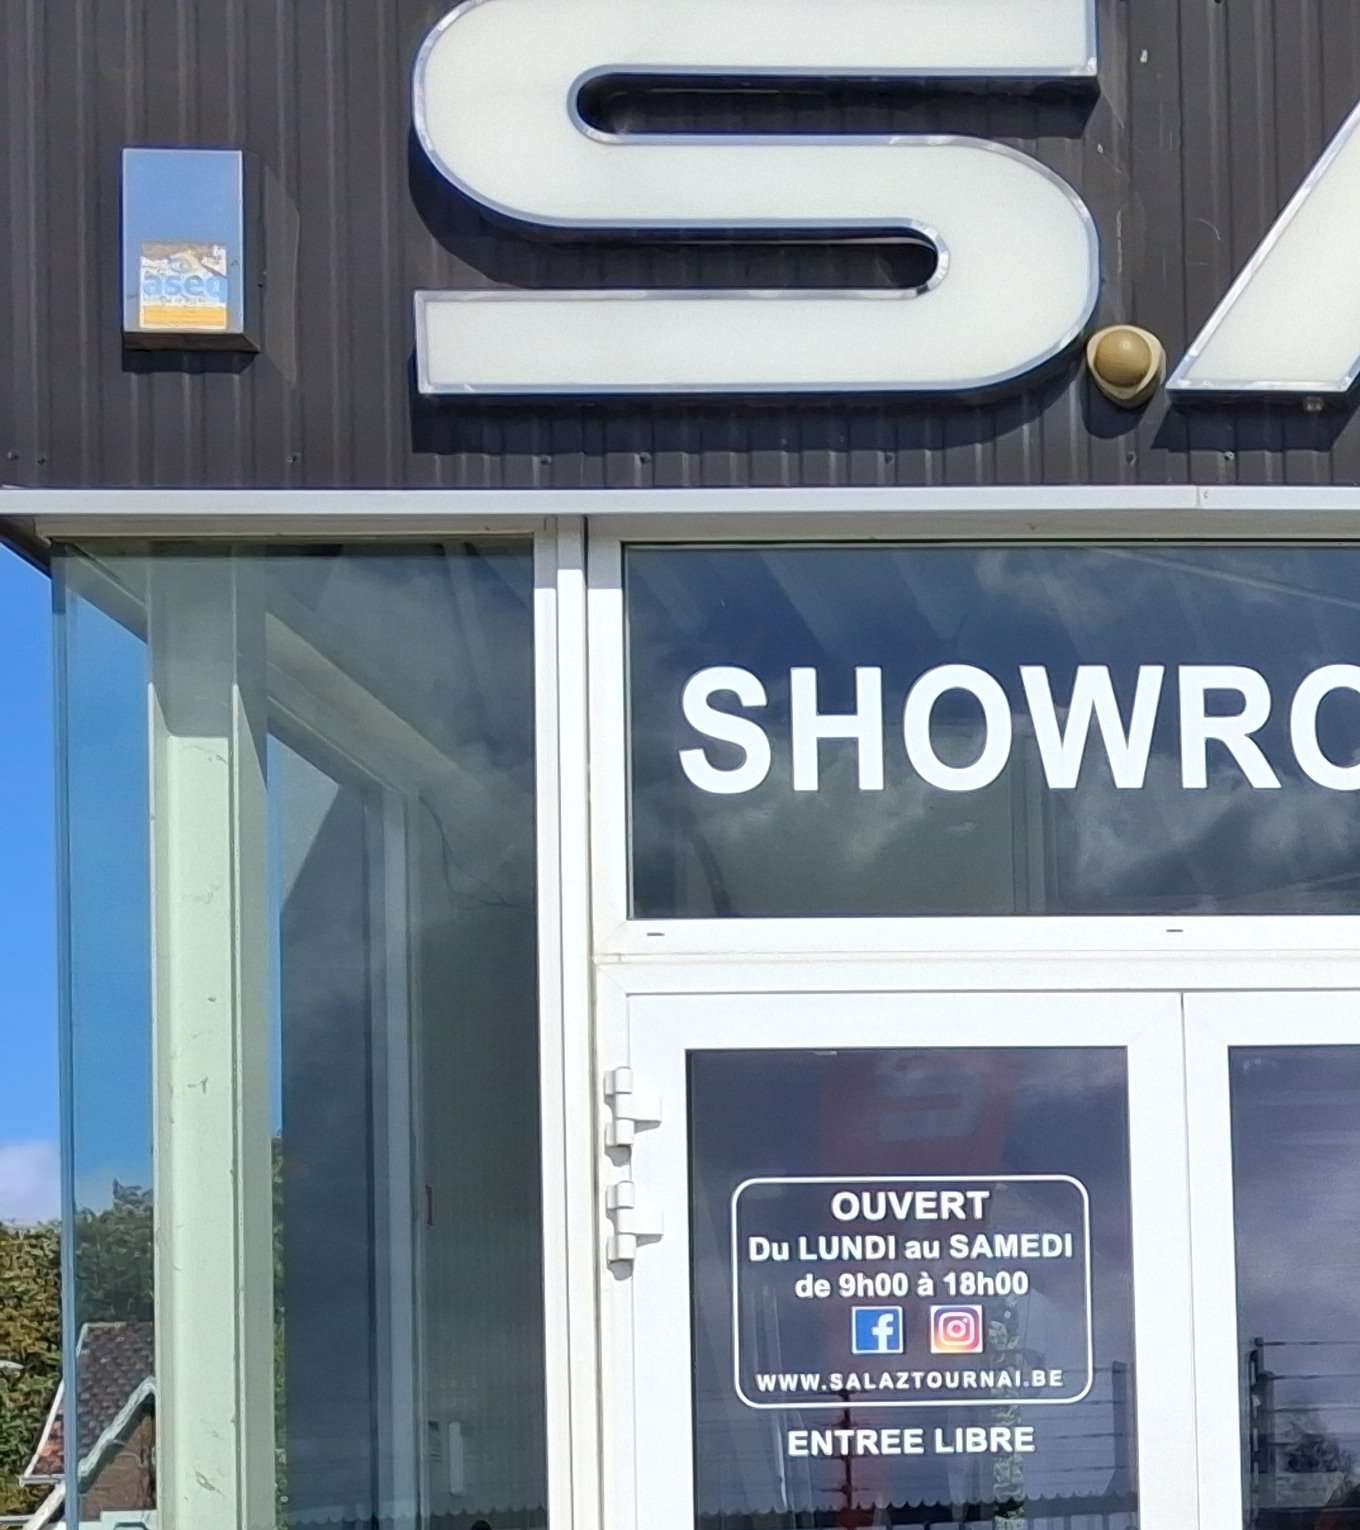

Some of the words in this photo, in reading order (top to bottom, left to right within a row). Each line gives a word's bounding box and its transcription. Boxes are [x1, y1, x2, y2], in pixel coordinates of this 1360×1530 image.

[832, 1191, 990, 1221] OUVERT
[748, 1236, 789, 1261] Du
[798, 1235, 896, 1261] LUNDI
[904, 1240, 940, 1260] au
[950, 1232, 1073, 1259] SAMEDI
[794, 1271, 831, 1298] de
[838, 1271, 909, 1298] 9h00
[916, 1270, 935, 1297] à
[942, 1270, 1029, 1297] 18h00
[756, 1368, 1064, 1393] WWW.SALAZTOURNAI.BE
[786, 1427, 925, 1457] ENTREE
[934, 1426, 1036, 1454] LIBRE
